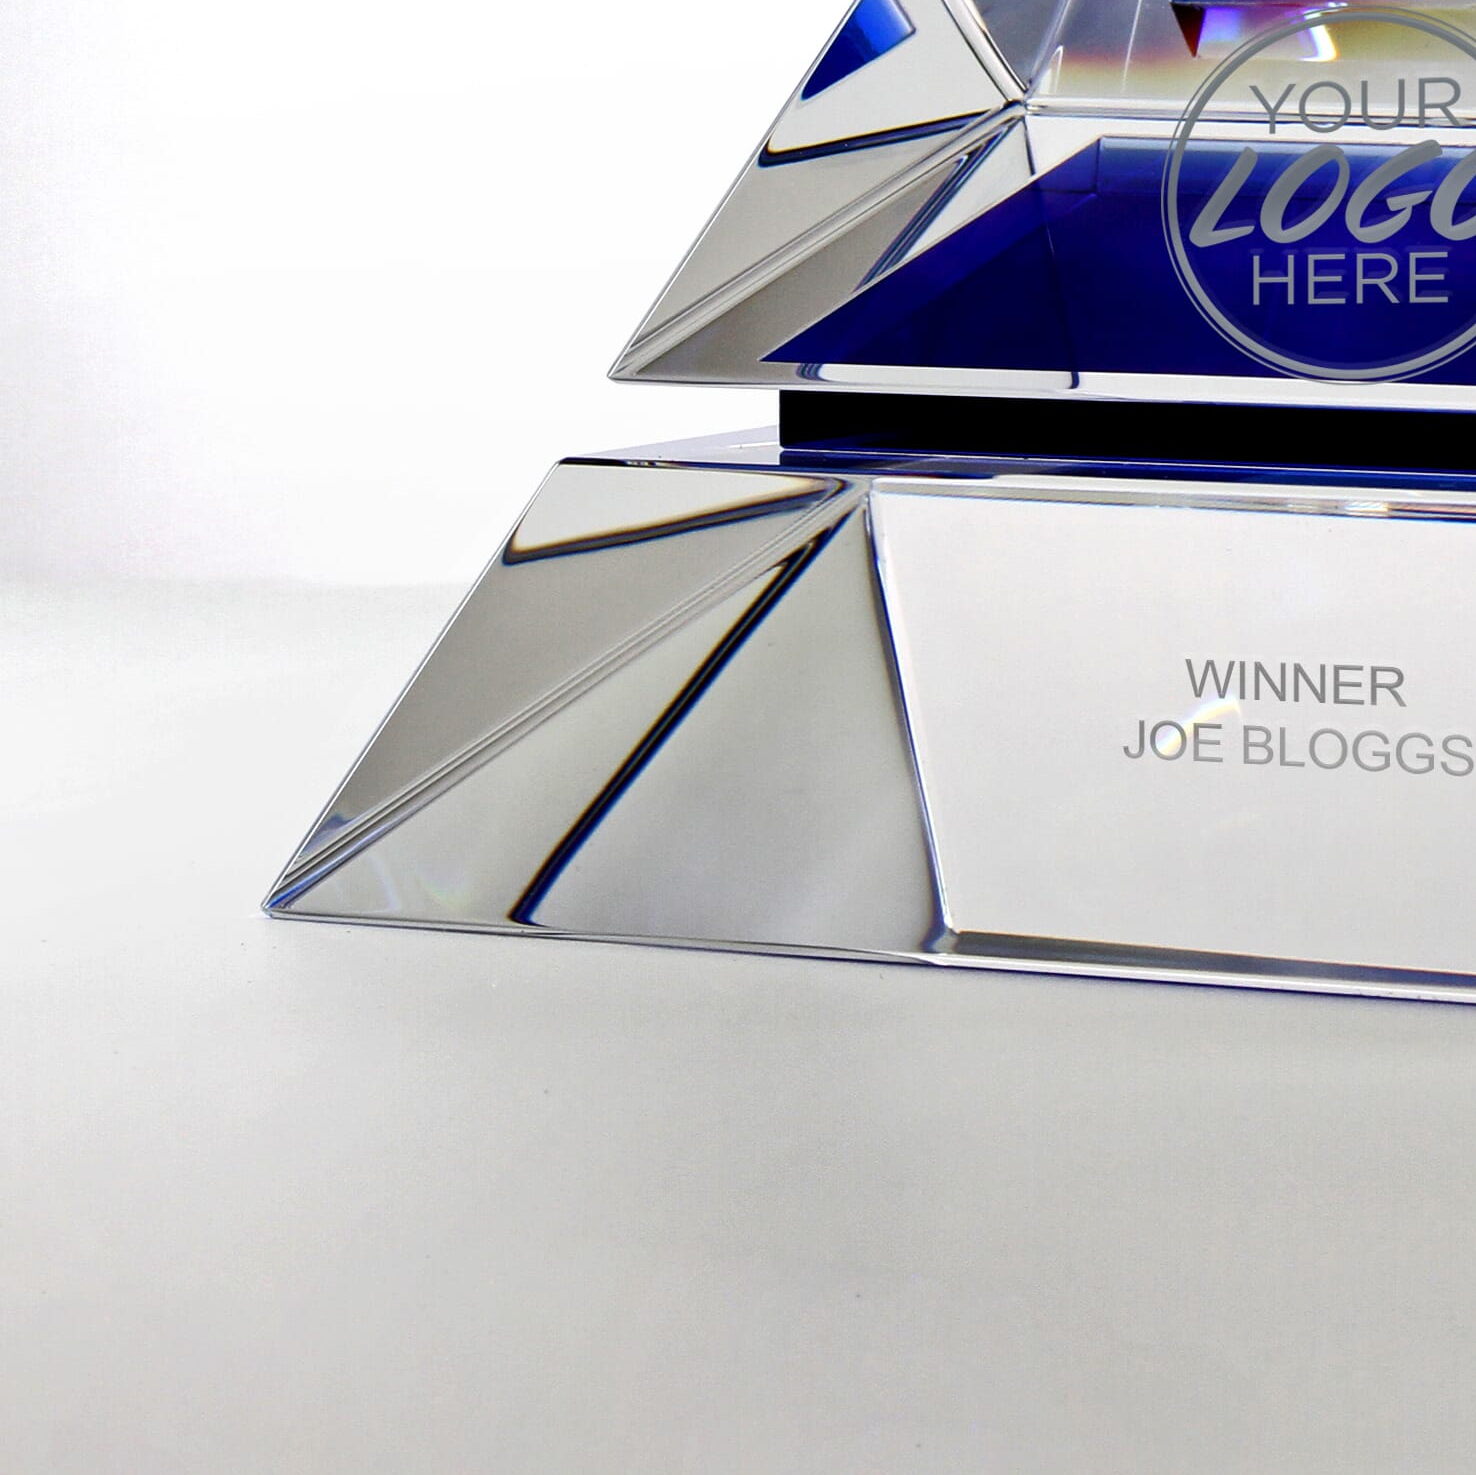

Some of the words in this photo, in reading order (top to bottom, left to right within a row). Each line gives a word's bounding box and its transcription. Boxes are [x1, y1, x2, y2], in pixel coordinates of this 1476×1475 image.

[1249, 77, 1462, 135] YOUR
[1252, 251, 1450, 306] HERE
[1185, 658, 1407, 708] WINNER
[1122, 720, 1224, 764] JOE
[1242, 724, 1475, 777] BLOGGS
